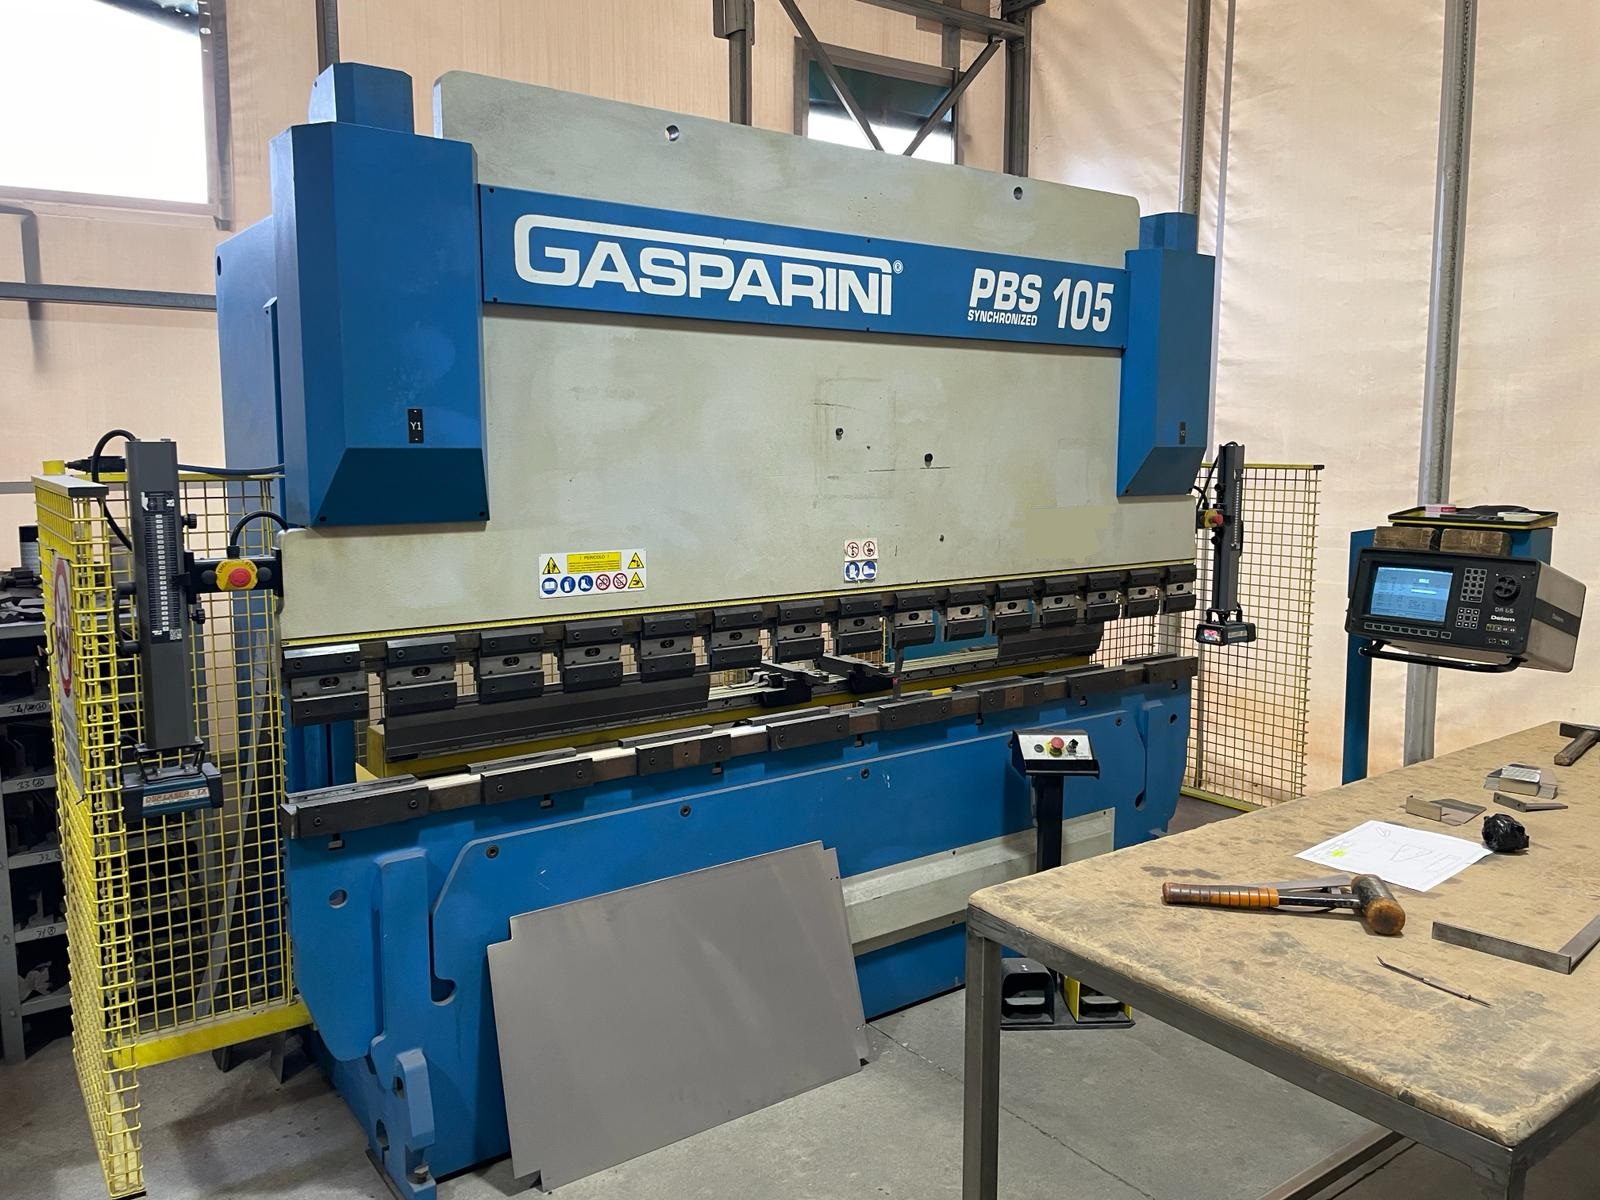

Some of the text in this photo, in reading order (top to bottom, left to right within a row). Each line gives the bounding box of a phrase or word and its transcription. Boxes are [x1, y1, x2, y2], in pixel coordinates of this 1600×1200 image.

[969, 268, 1114, 332] PBS 105
[967, 309, 1038, 326] SYNCHRONIZED
[410, 422, 422, 430] Y1
